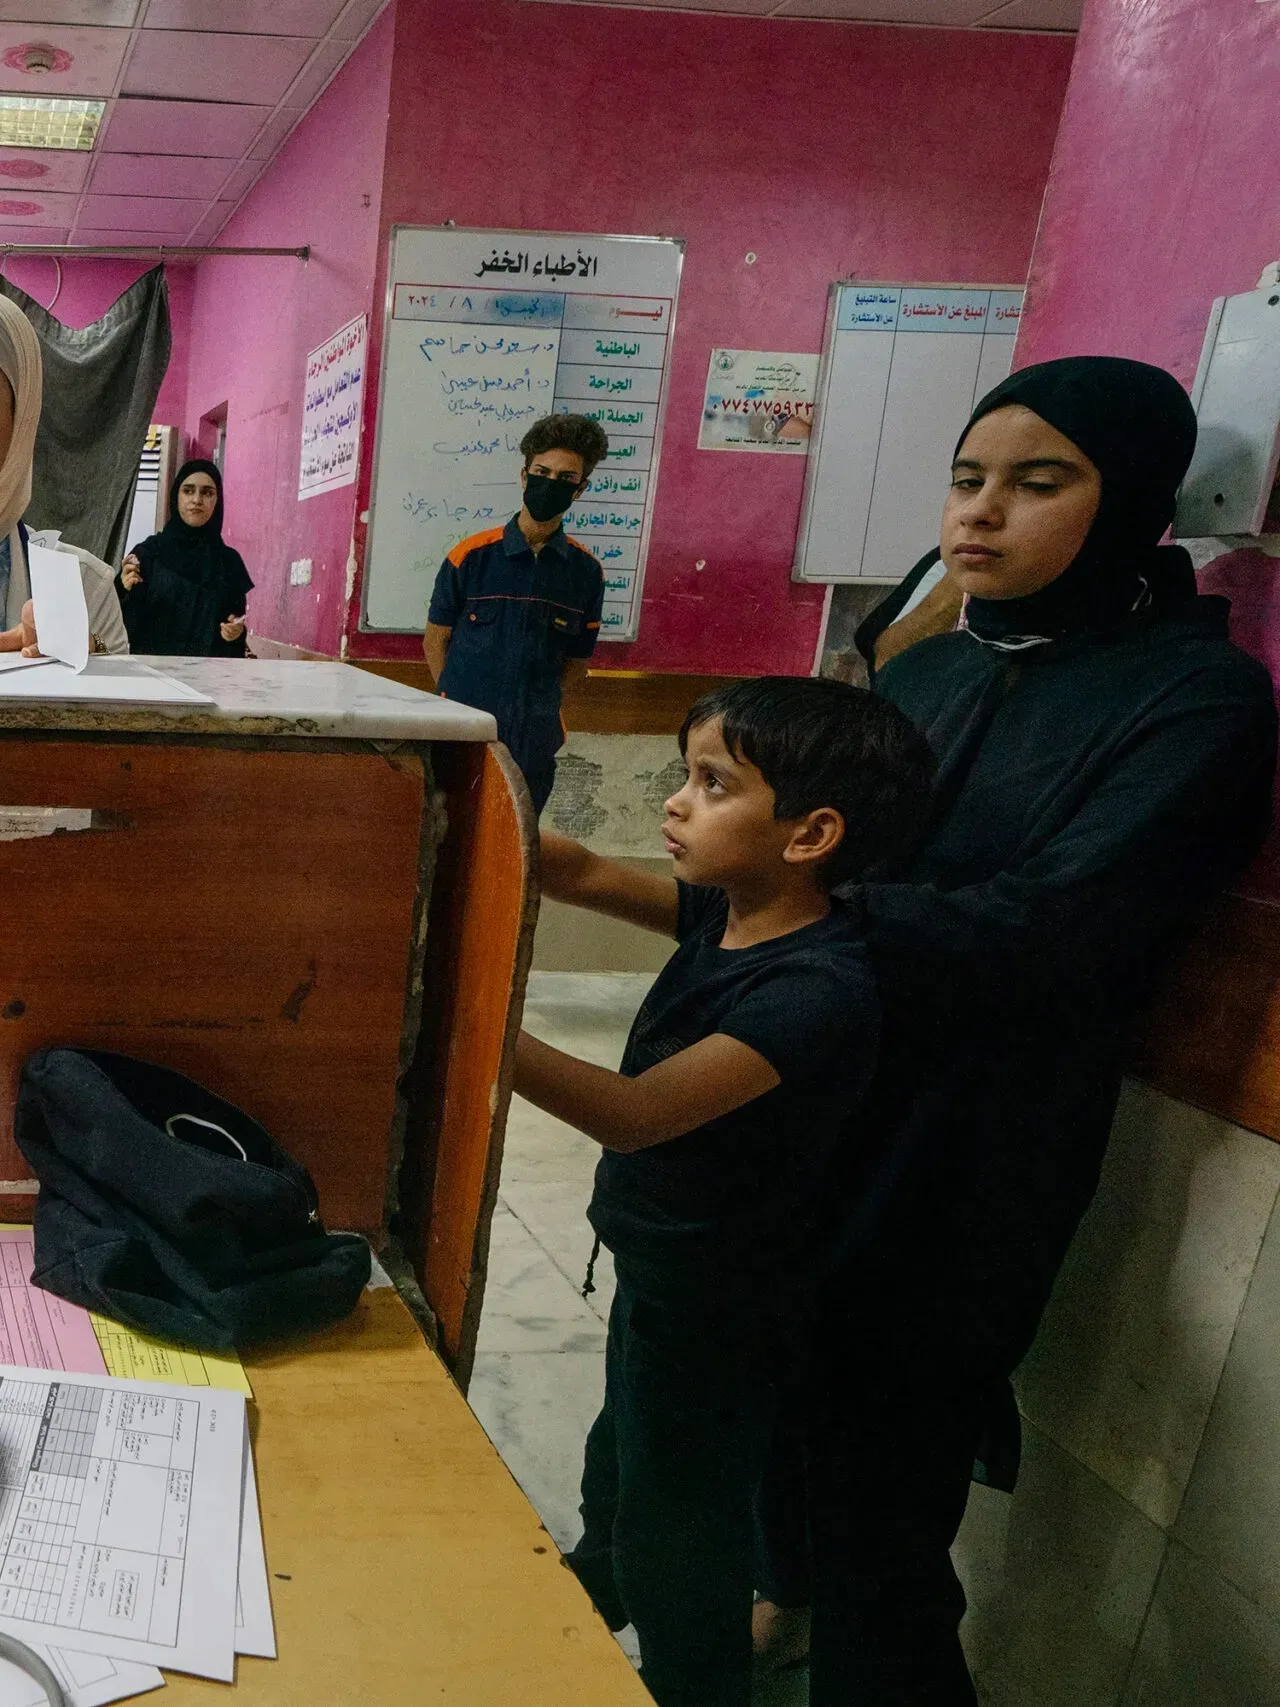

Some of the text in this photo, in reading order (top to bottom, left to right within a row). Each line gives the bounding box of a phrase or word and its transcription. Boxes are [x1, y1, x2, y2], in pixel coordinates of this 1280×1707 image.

[474, 249, 598, 281] الأطباء الخفر
[963, 307, 987, 322] المبلغ
[595, 339, 641, 358] الباطنية
[589, 375, 632, 392] الجراحة
[607, 409, 643, 427] الجملة
[609, 513, 641, 531] جراحة
[600, 545, 623, 561] خفر
